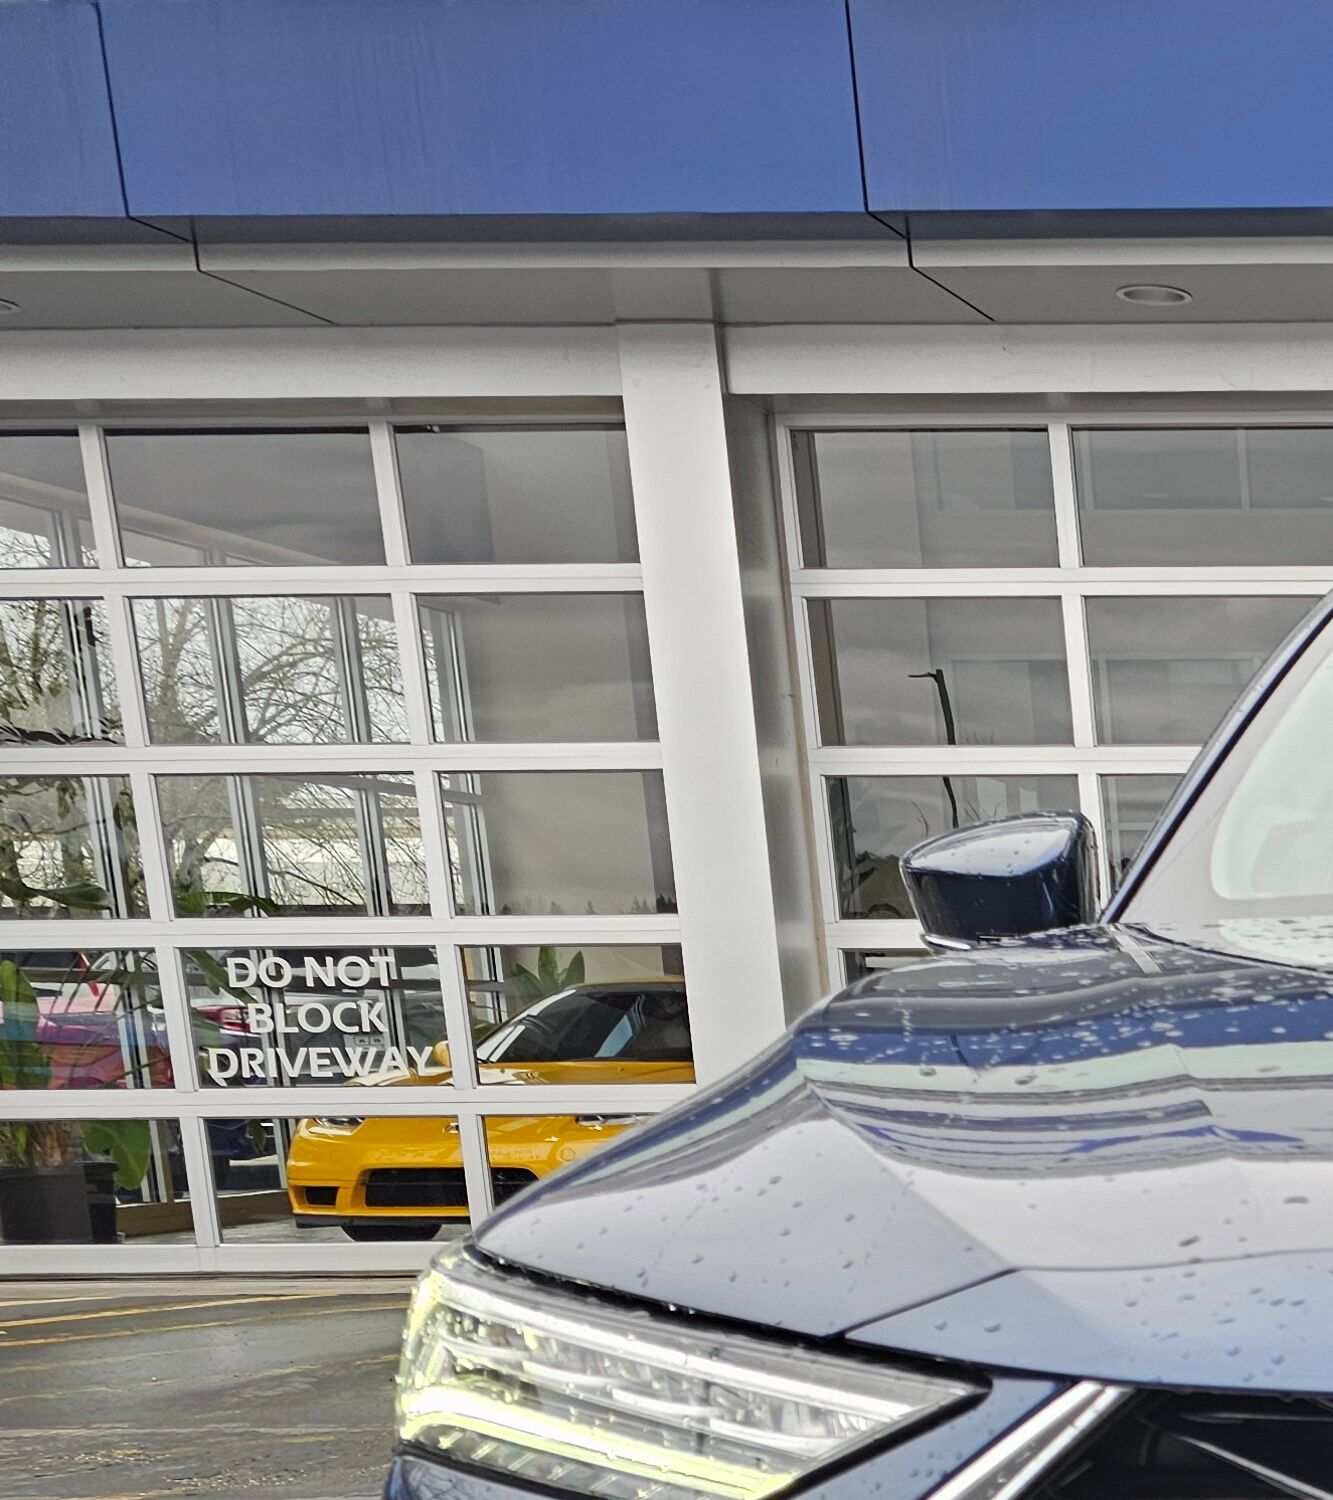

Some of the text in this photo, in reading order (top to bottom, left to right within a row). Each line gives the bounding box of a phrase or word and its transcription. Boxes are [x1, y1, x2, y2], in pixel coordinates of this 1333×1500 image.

[227, 955, 396, 988] DO NOT
[247, 1001, 389, 1034] BLOCK
[207, 1046, 434, 1079] DRIVEWAY
